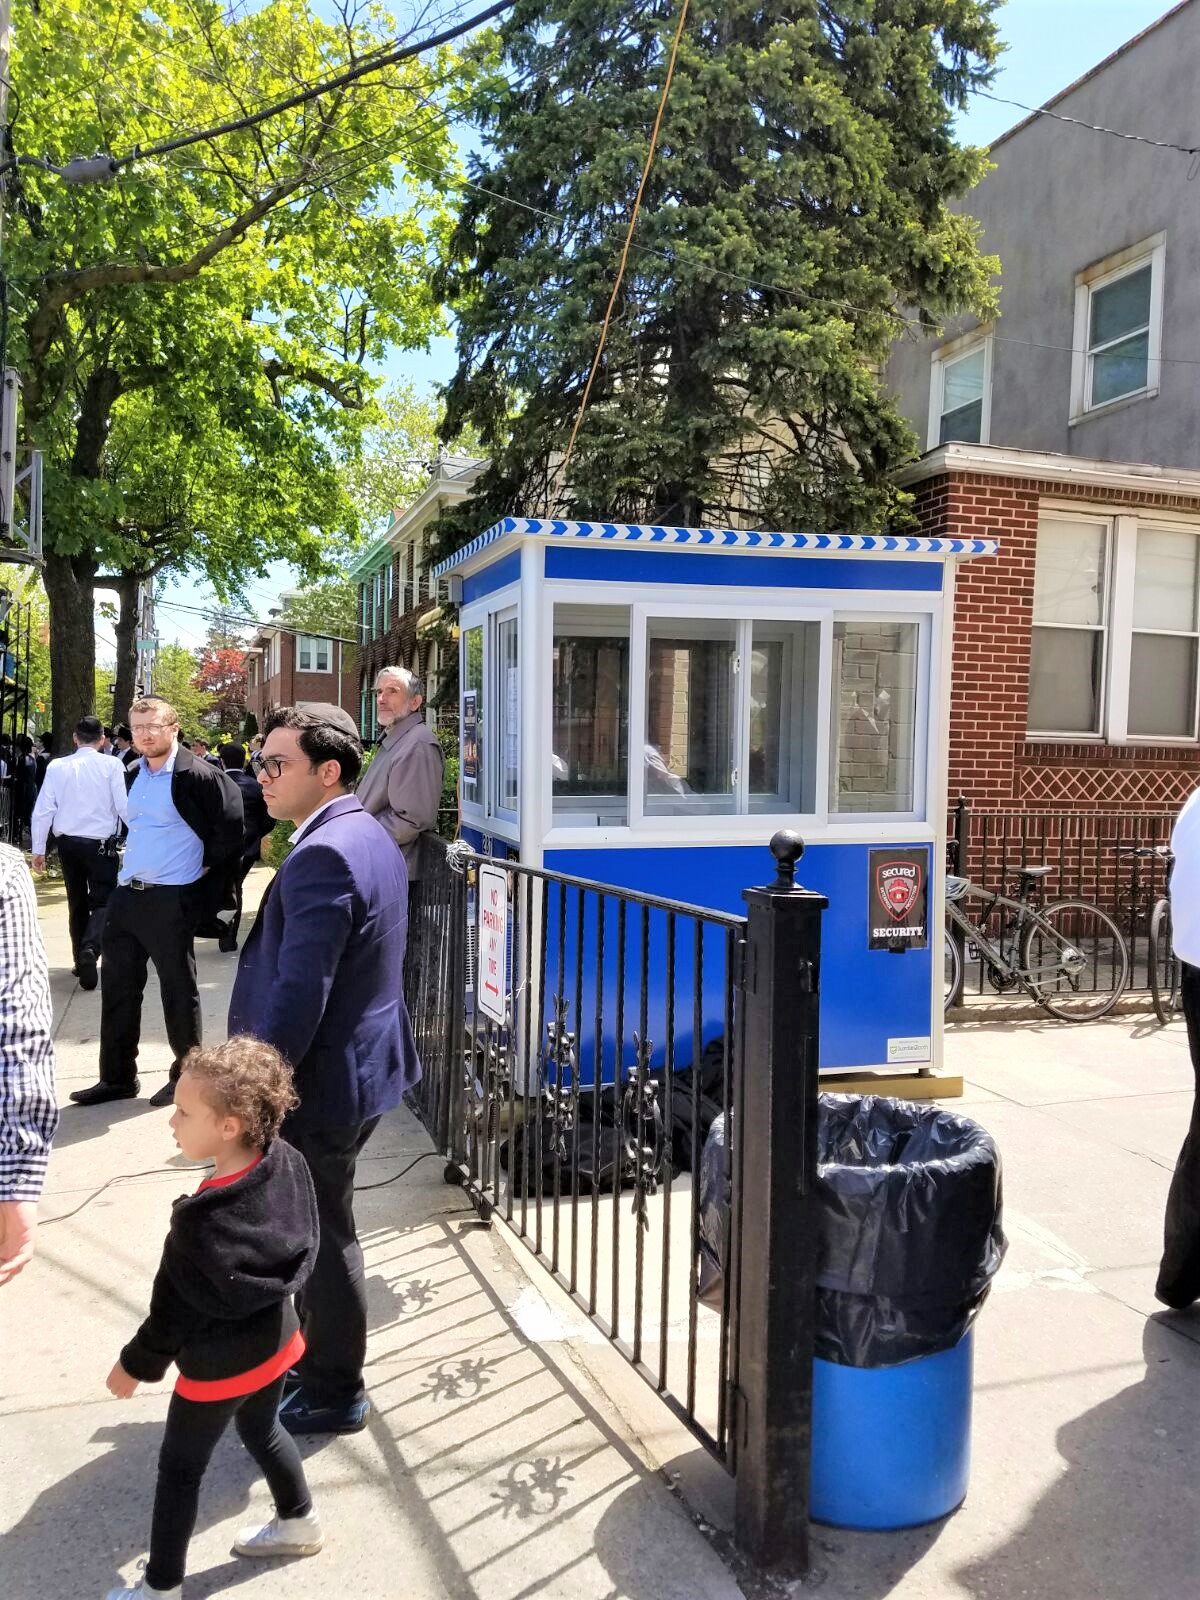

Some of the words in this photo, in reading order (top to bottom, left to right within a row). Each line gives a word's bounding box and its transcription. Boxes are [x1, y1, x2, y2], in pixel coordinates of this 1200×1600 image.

[882, 866, 916, 878] secured
[490, 888, 498, 907] NO
[483, 909, 504, 934] PARKING
[873, 927, 924, 938] SECURITY
[489, 936, 498, 951] ANY
[488, 957, 497, 976] TIME
